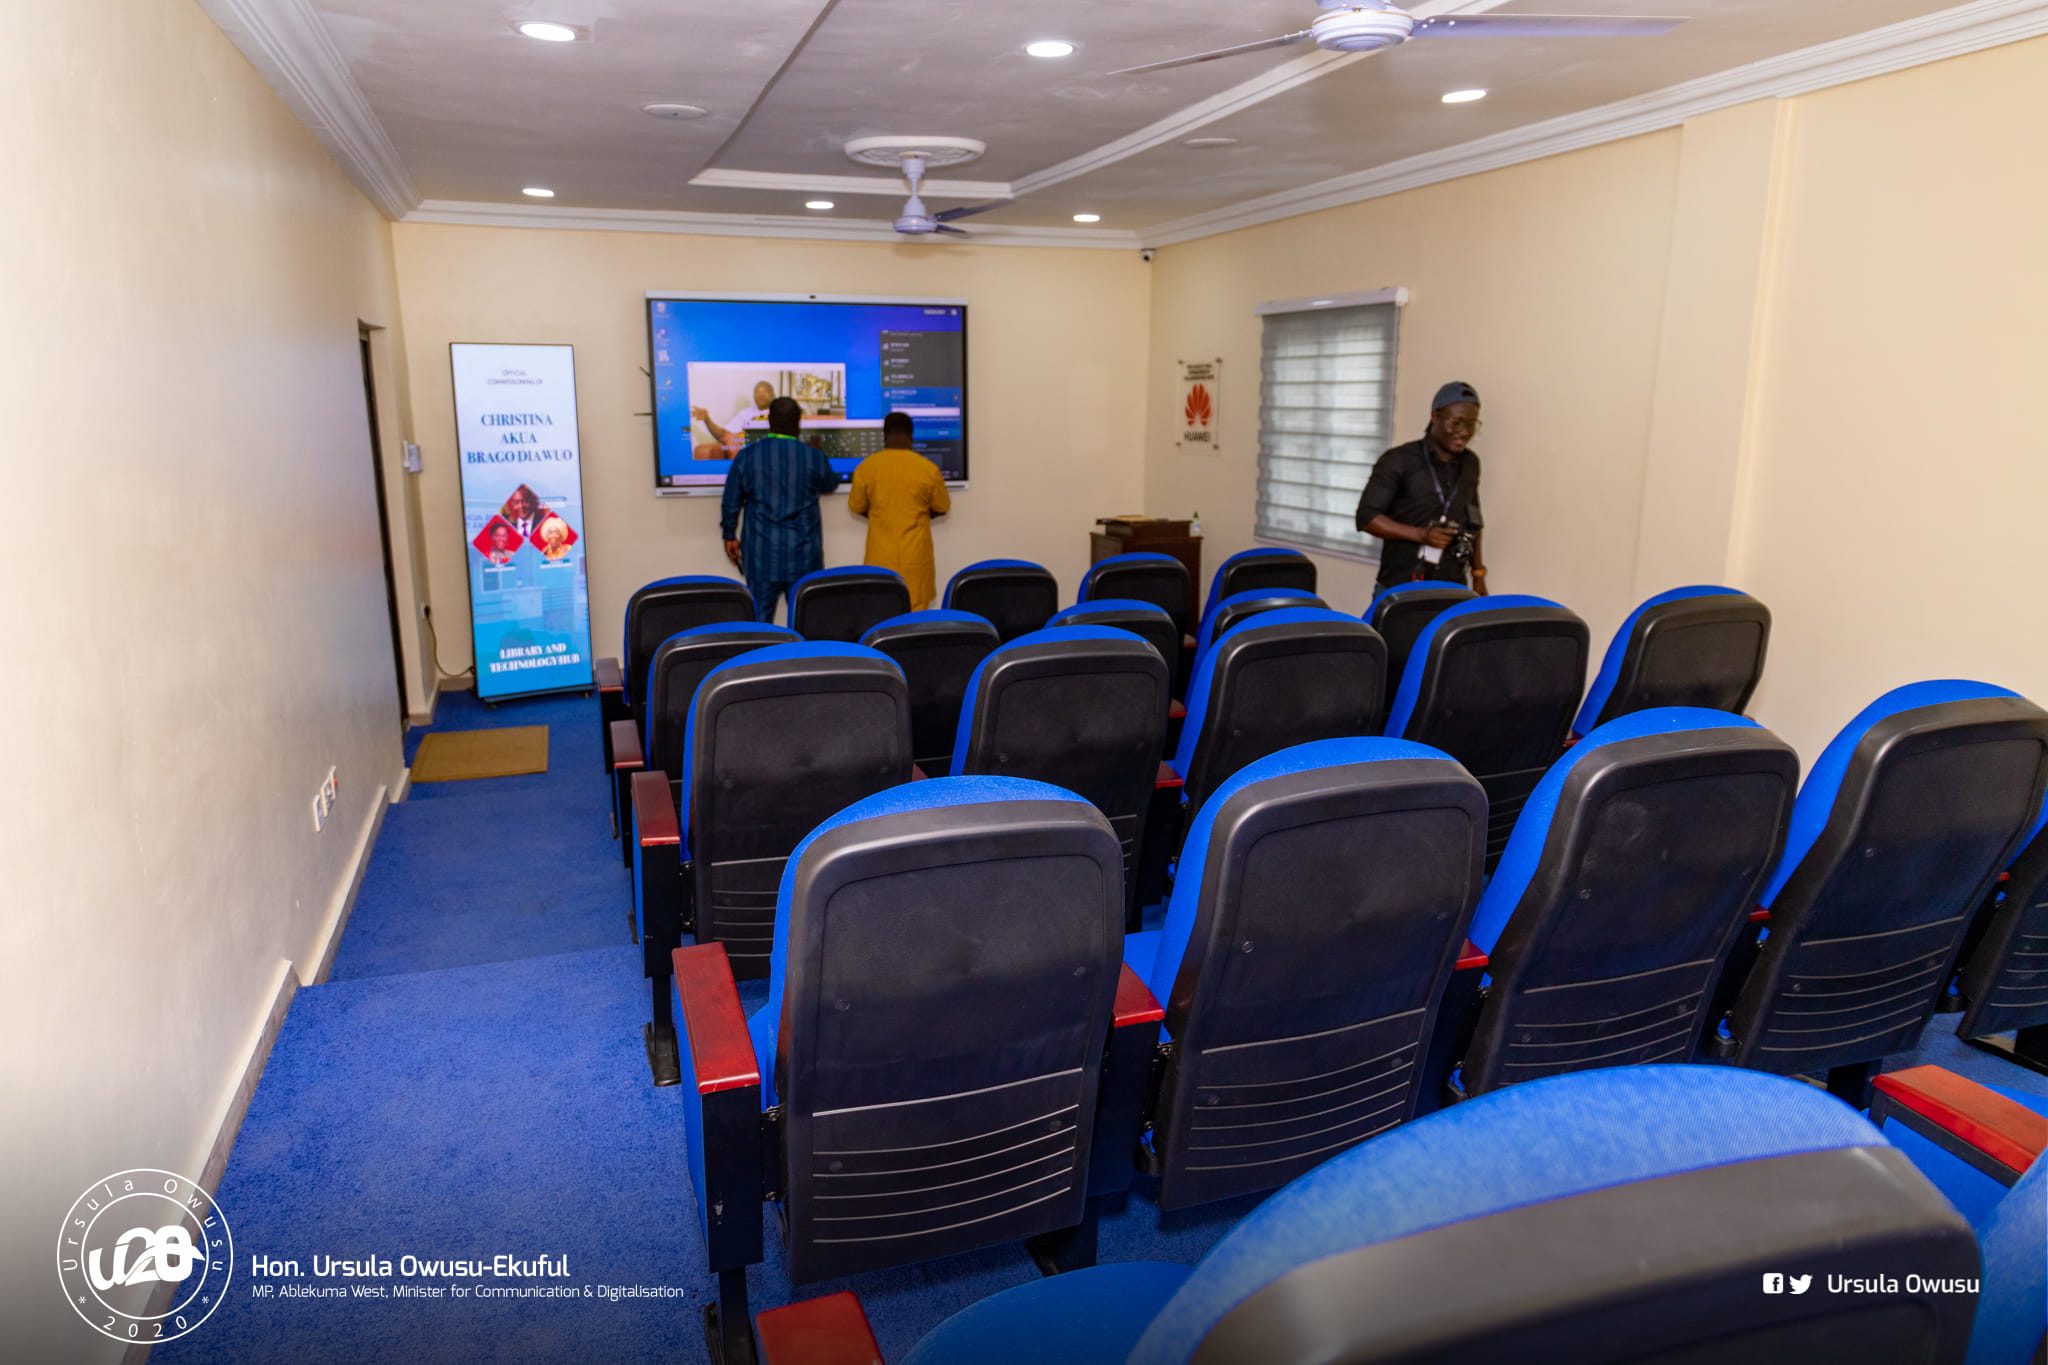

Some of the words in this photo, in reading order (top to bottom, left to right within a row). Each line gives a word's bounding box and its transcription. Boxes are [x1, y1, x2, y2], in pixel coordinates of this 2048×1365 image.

[480, 413, 553, 427] CHRISTINA
[501, 431, 538, 445] AKUA
[1184, 431, 1211, 442] HUAWEI
[466, 450, 515, 465] BRAGO
[518, 449, 573, 463] DIAWUO
[499, 644, 542, 660] LIBRARY
[545, 642, 567, 655] AND
[489, 656, 558, 674] TECHNOLOGY
[558, 653, 580, 666] HUB
